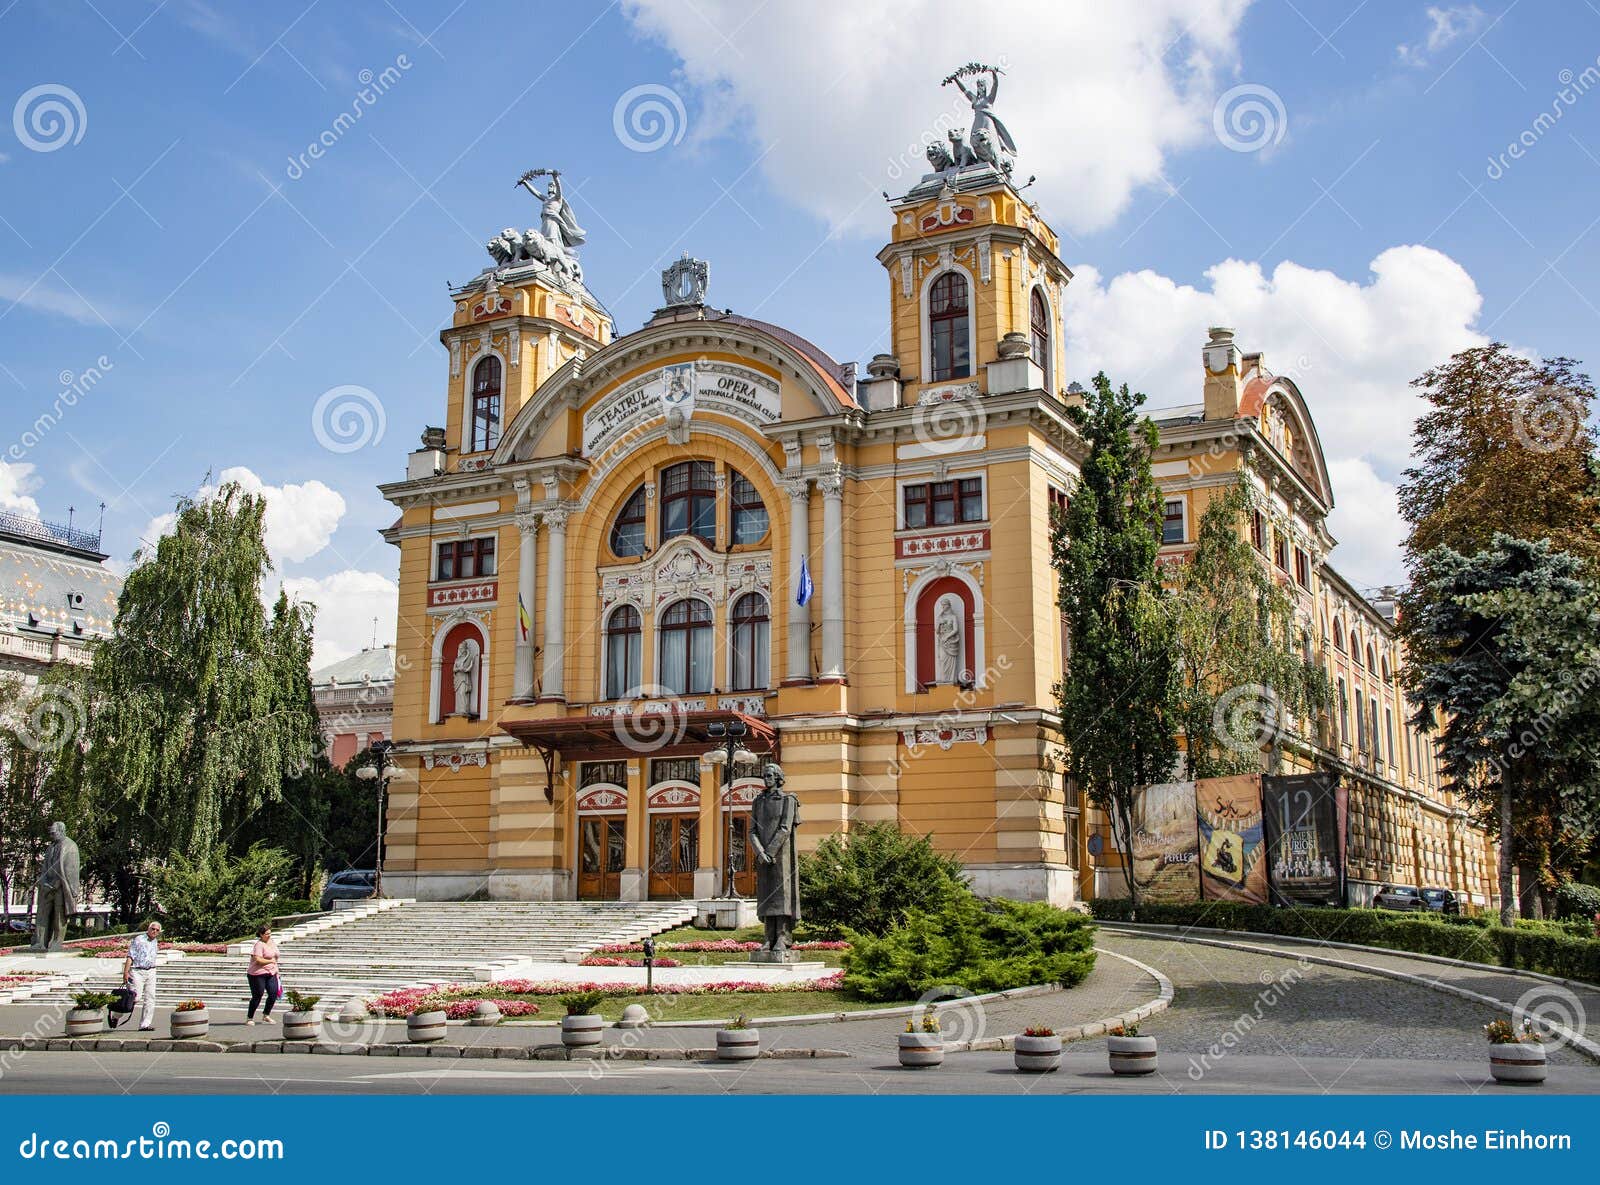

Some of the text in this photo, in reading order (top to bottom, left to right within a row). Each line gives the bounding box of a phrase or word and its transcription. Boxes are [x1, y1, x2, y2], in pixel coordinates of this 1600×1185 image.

[717, 377, 757, 399] OPERA
[598, 389, 649, 427] TEATRUL
[1278, 789, 1317, 833] 12
